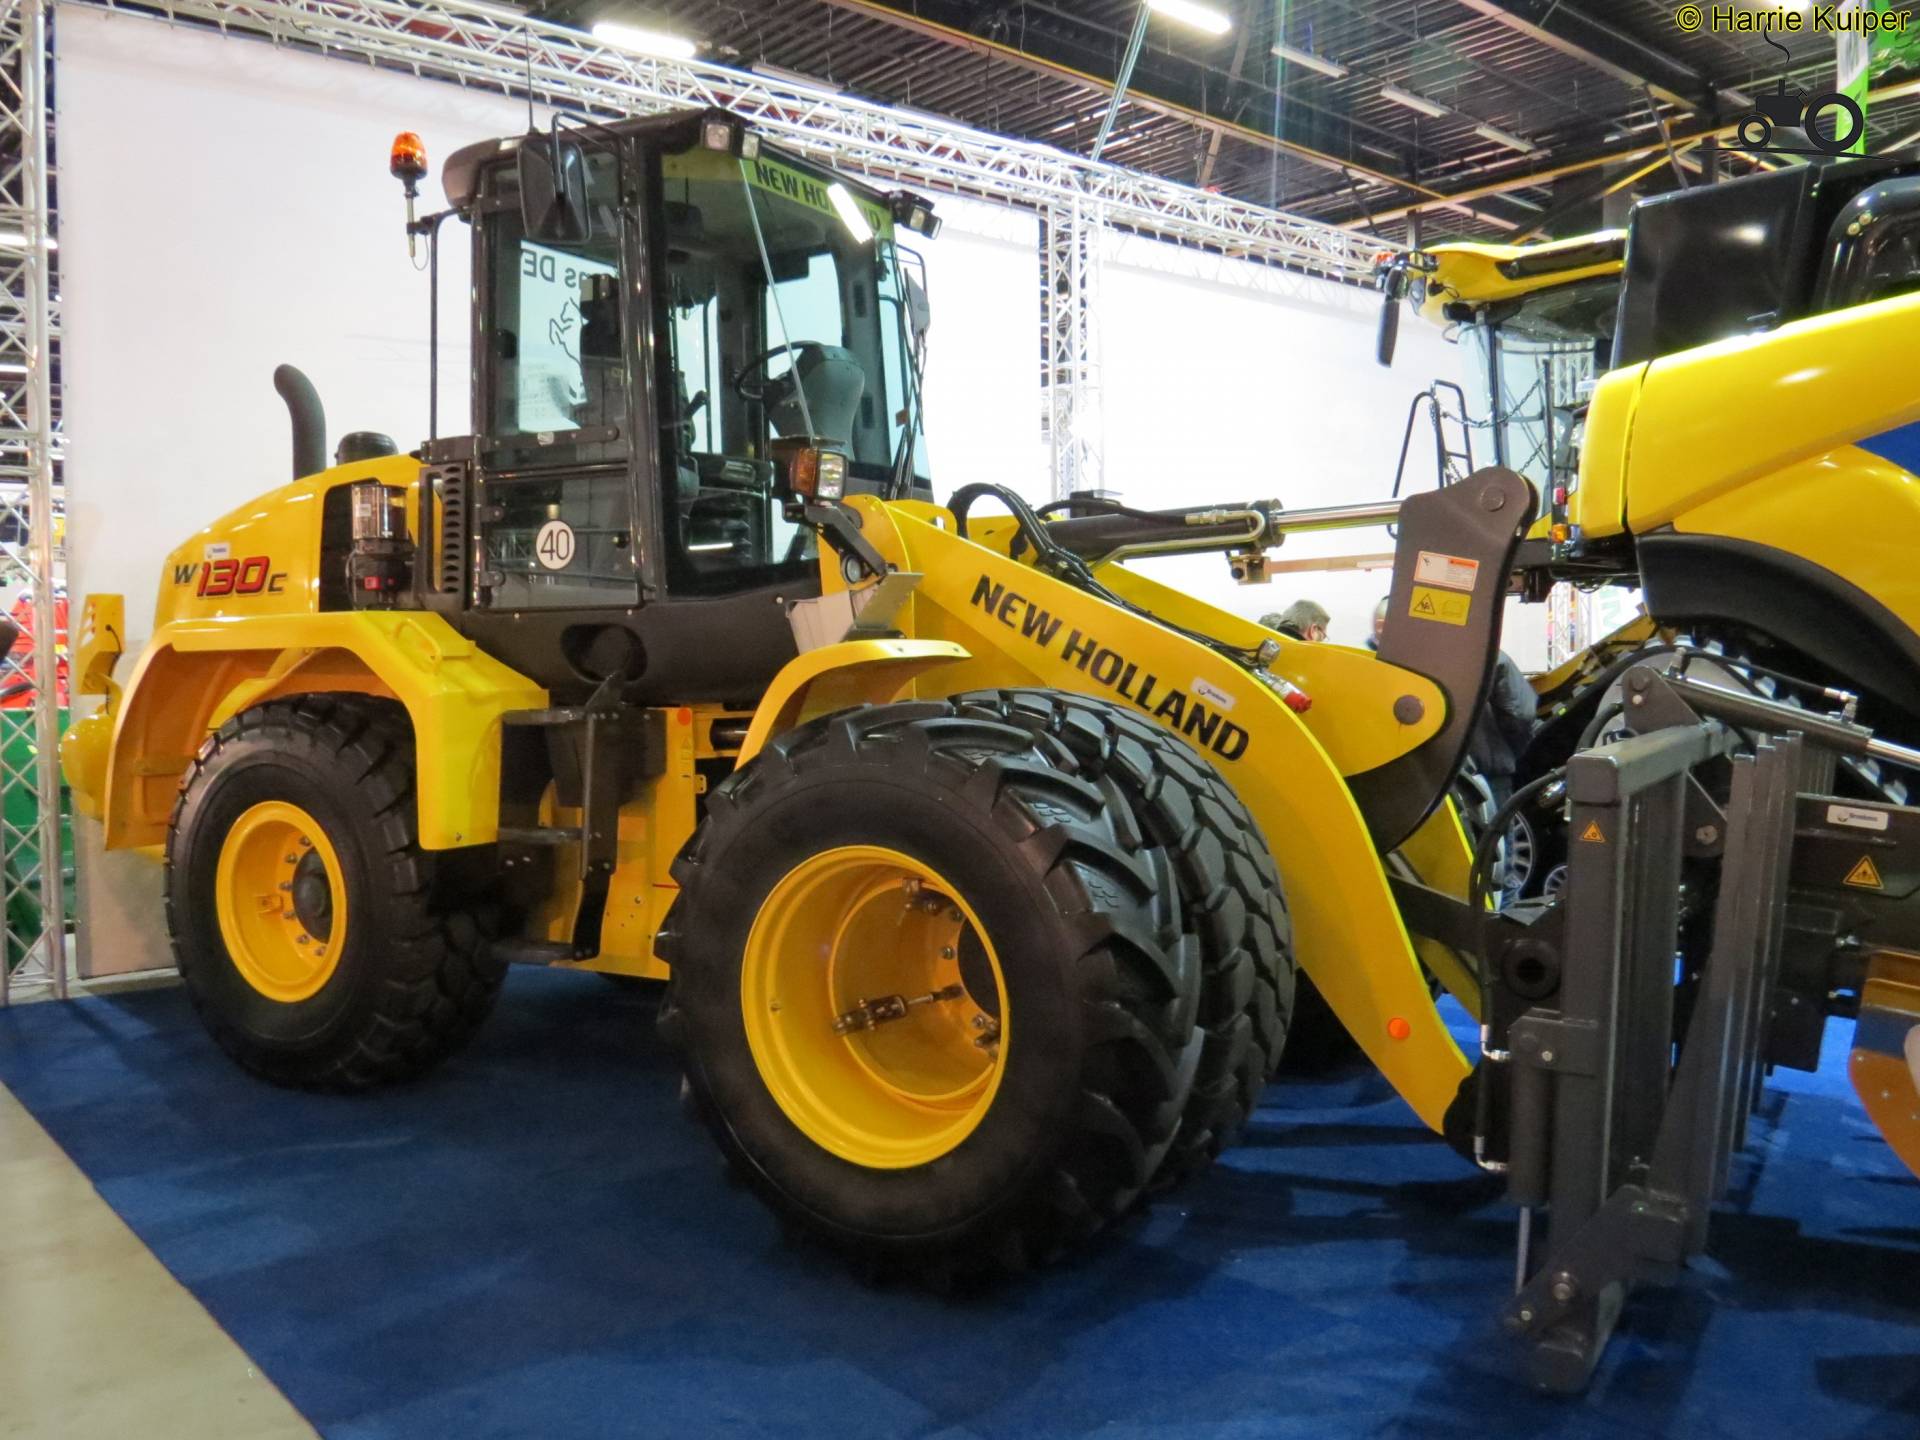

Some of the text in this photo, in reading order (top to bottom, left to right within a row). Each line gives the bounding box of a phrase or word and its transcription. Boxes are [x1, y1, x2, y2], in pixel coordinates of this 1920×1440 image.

[754, 160, 799, 199] NEW
[540, 529, 570, 560] 40
[970, 574, 1249, 762] NEW HOLLAND
